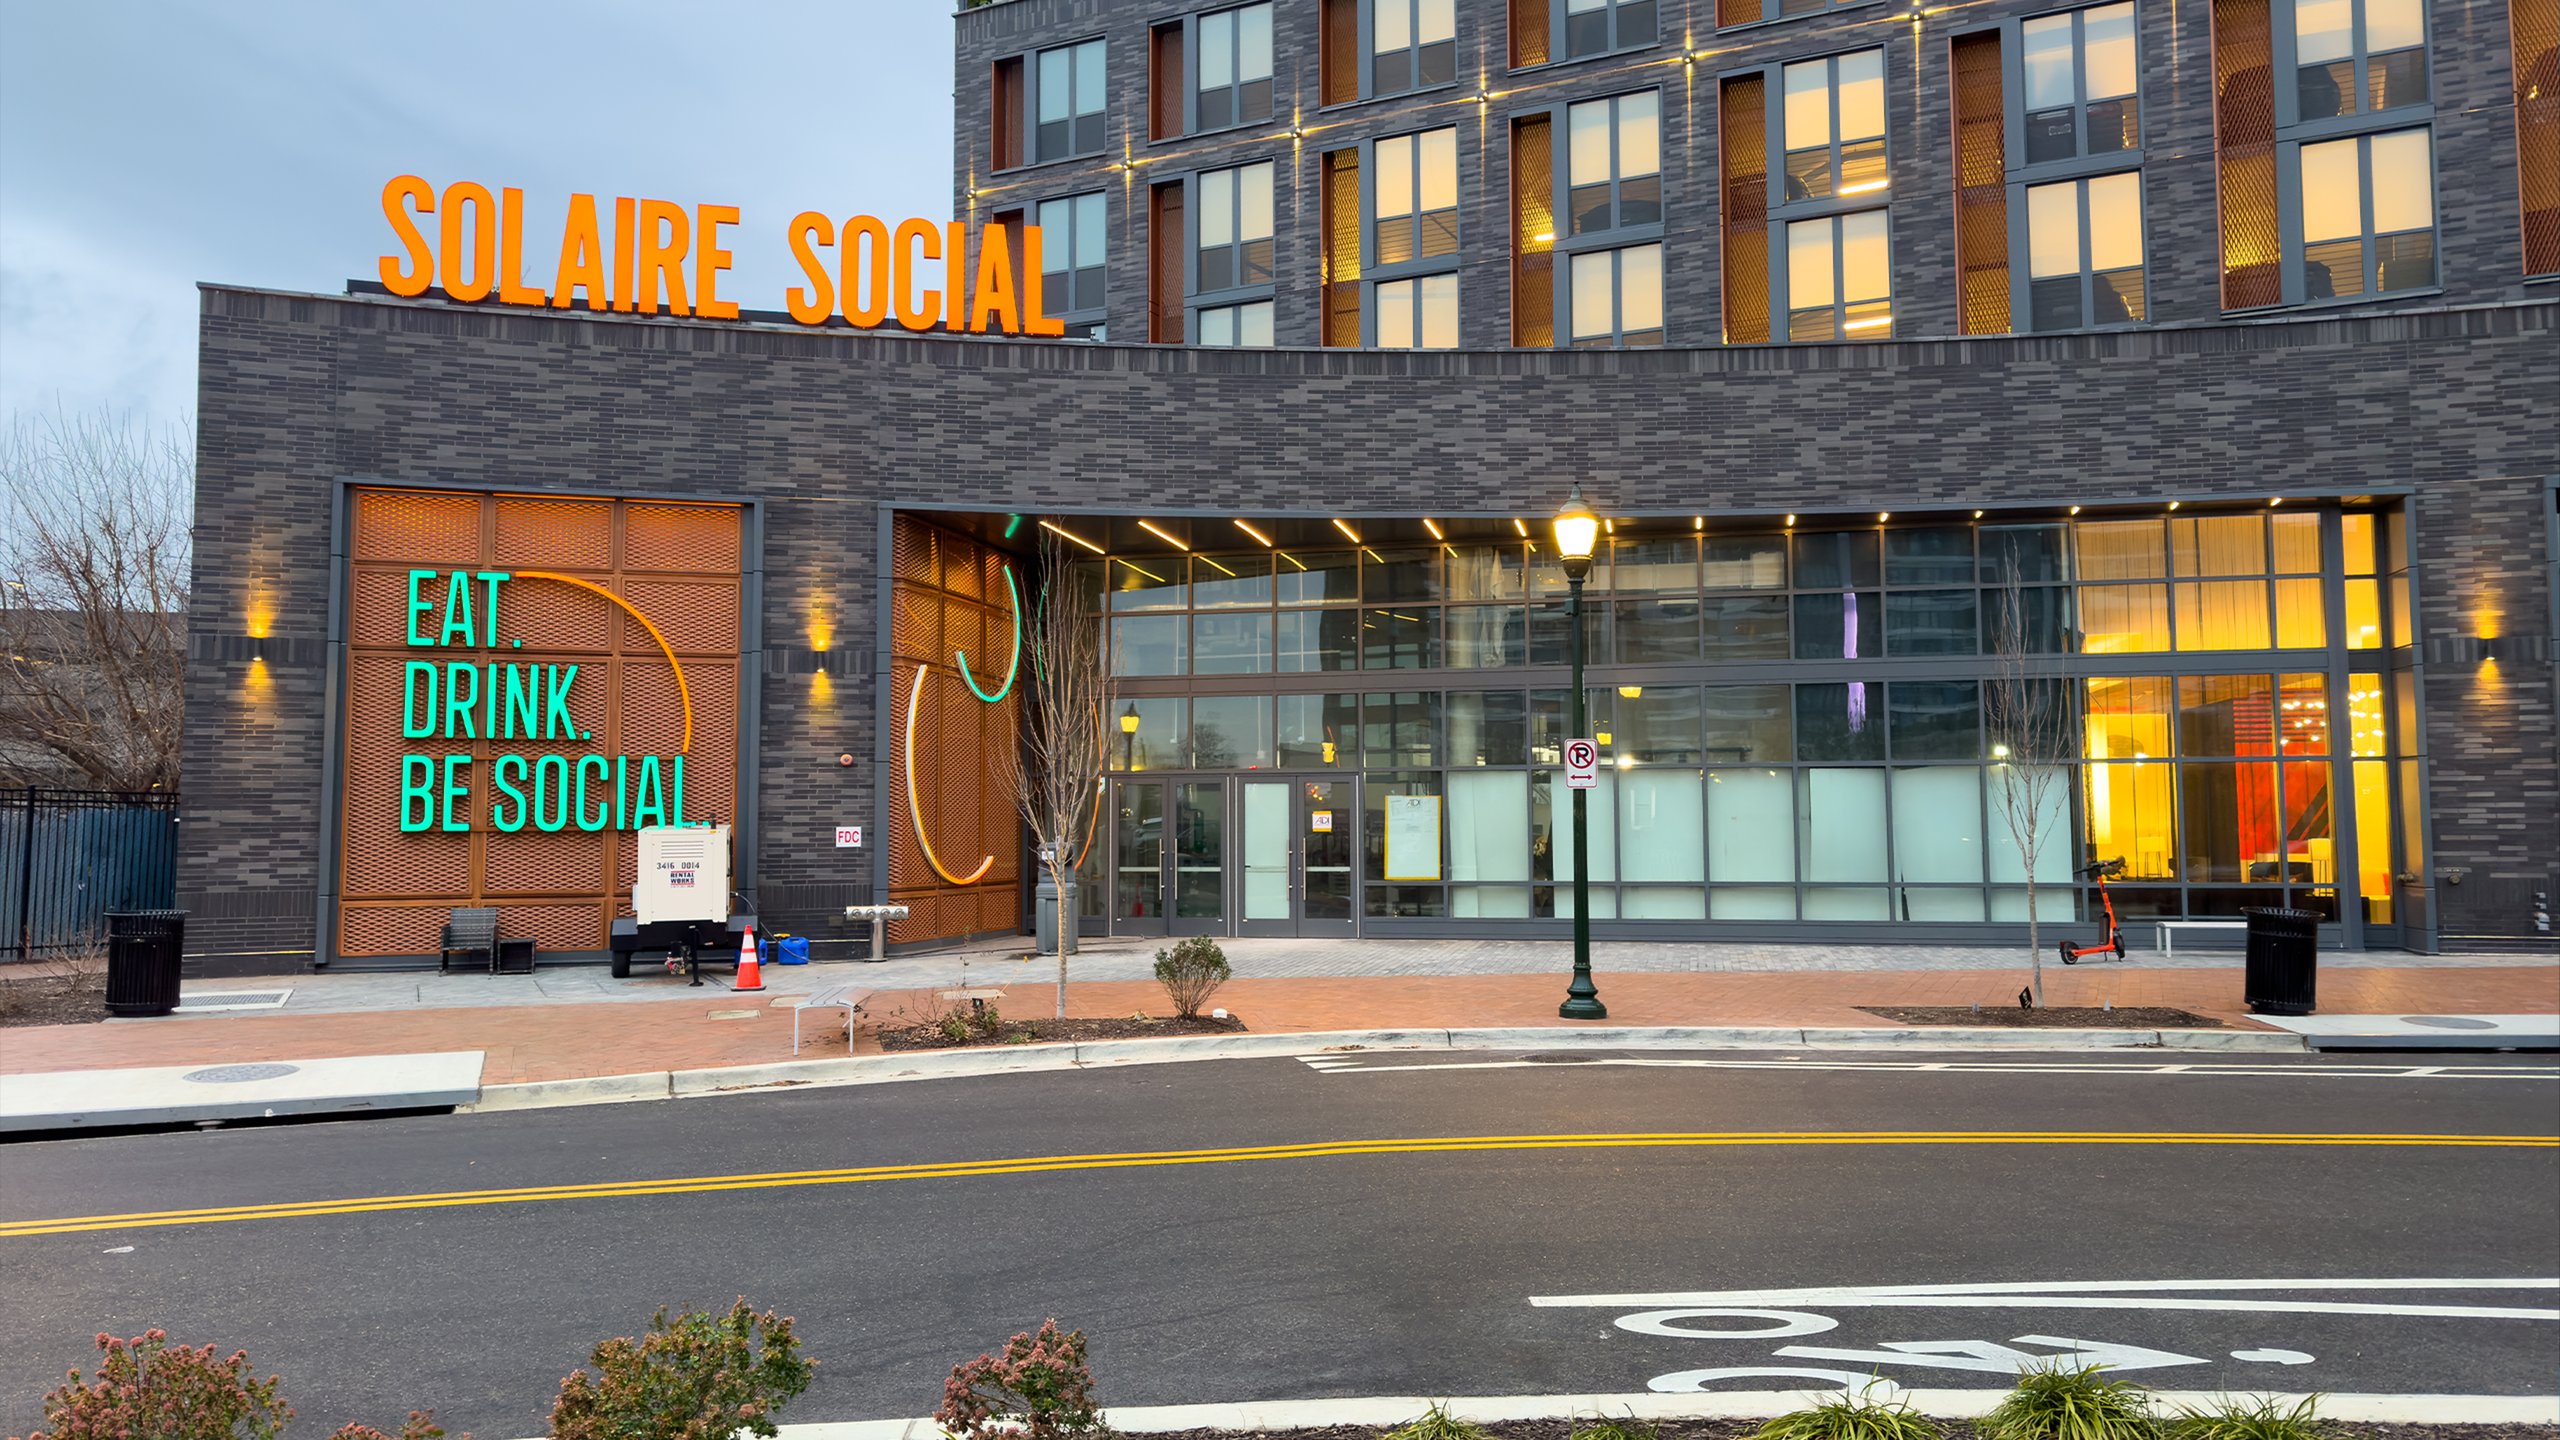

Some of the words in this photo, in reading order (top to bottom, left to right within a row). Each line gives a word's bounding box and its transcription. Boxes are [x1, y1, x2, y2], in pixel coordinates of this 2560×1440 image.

[379, 175, 740, 319] SOLAIRE
[786, 211, 1064, 336] SOCIAL
[407, 569, 521, 648] EAT.
[403, 661, 591, 740] DRINK.
[400, 754, 472, 832] BE
[656, 862, 675, 870] 3416
[838, 831, 860, 843] FDC
